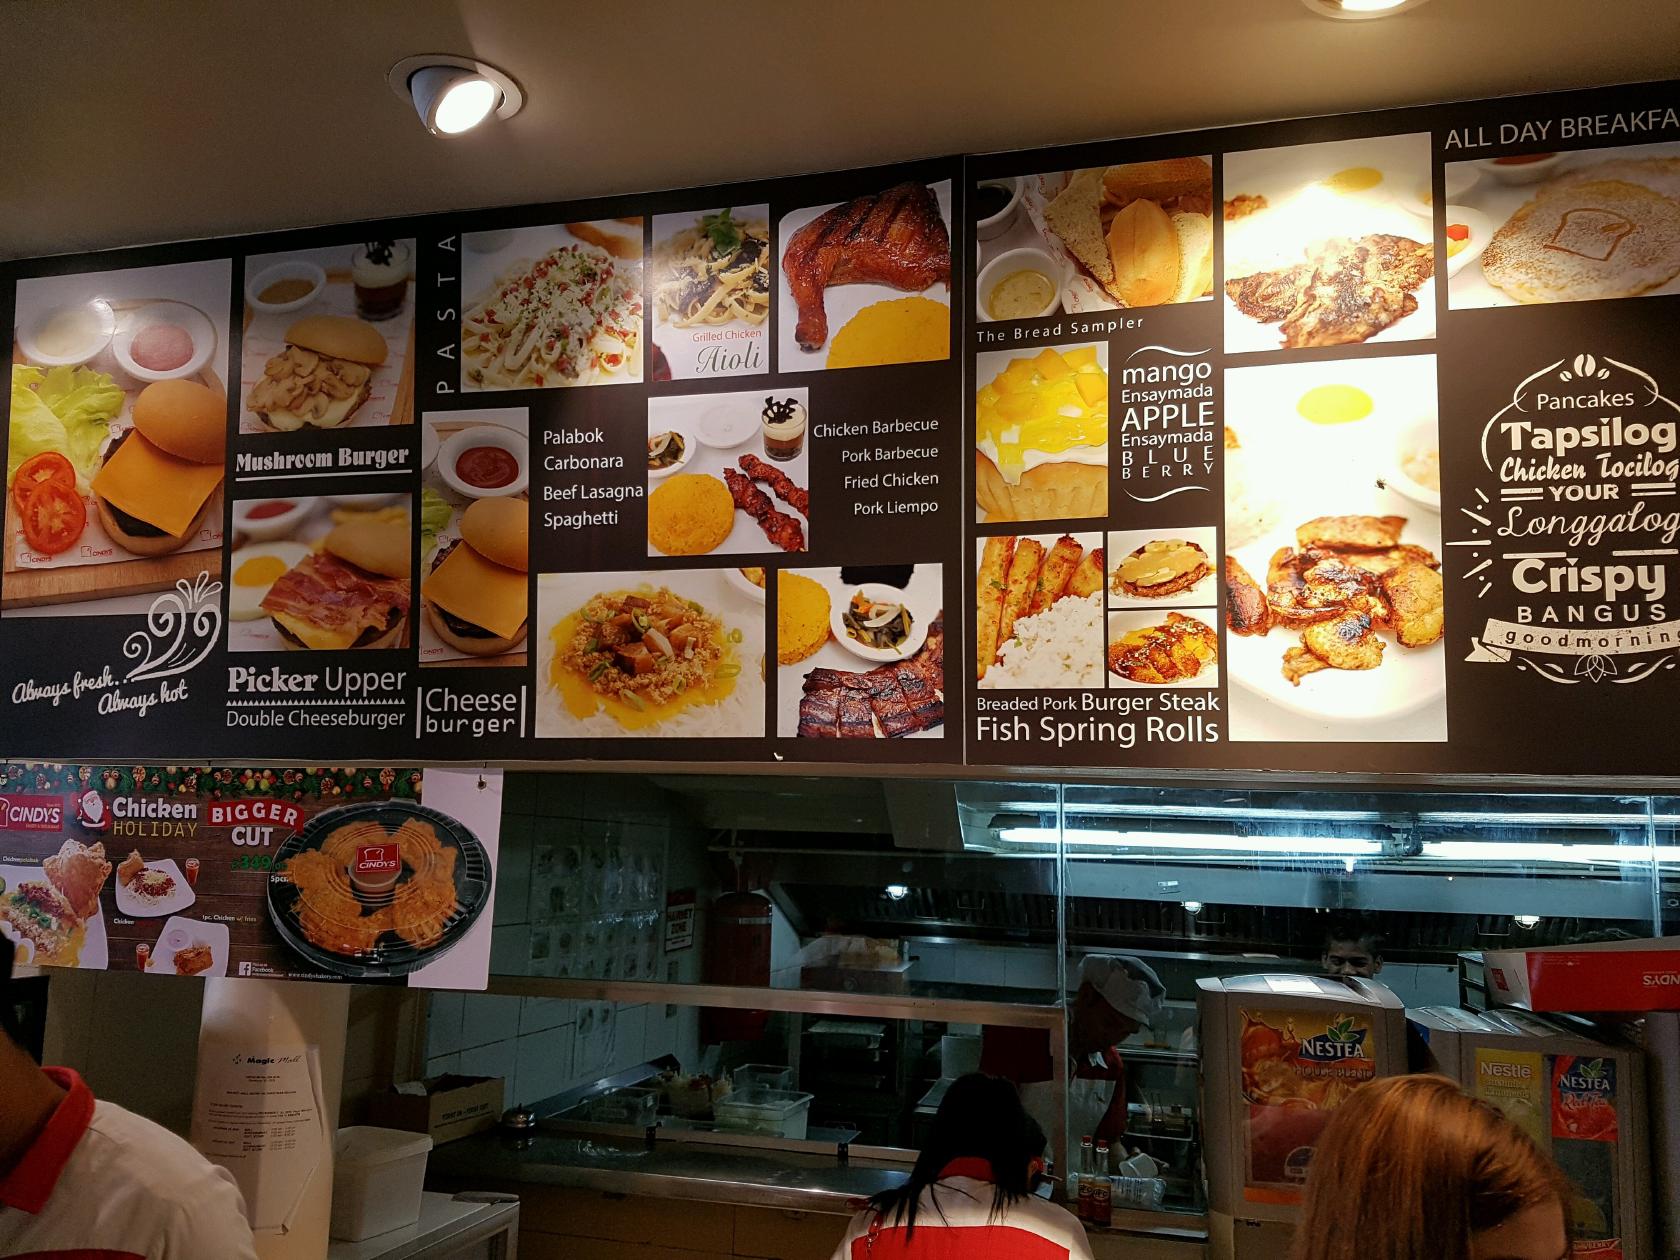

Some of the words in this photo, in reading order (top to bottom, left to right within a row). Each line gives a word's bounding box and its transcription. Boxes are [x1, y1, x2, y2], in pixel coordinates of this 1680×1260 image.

[1444, 127, 1492, 150] ALL
[1500, 120, 1552, 144] DAY
[436, 235, 456, 394] PASTA
[692, 331, 723, 342] Grilled
[725, 330, 762, 340] Chicken
[977, 330, 1006, 343] The
[1014, 323, 1062, 340] Bread
[1070, 318, 1144, 335] Sampler
[695, 341, 763, 374] Aioli
[1122, 362, 1212, 386] mango
[1121, 384, 1213, 404] Ensaymada
[1537, 390, 1635, 411] Pancakes
[1121, 401, 1215, 431] APPLE
[543, 427, 605, 445] Palabok
[813, 422, 868, 437] Chicken
[872, 418, 939, 434] Barbecue
[1500, 416, 1677, 457] Tapsilog
[1121, 428, 1213, 449] Ensaymada
[236, 451, 333, 472] Mushroom
[338, 447, 409, 469] Burger
[544, 454, 624, 471] Carbonara
[842, 448, 871, 462] Pork
[875, 446, 939, 461] Barbecue
[1122, 445, 1214, 467] BLUE
[844, 474, 879, 489] Fried
[882, 471, 939, 487] Chicken
[1122, 462, 1214, 480] BERRY
[1500, 456, 1587, 483] Chicken
[543, 485, 578, 501] Beef
[581, 485, 643, 501] Lasagna
[1548, 484, 1619, 502] YOUR
[854, 501, 884, 515] Pork
[887, 501, 939, 515] Liempo
[544, 510, 618, 530] Spaghetti
[1497, 501, 1680, 547] Longgalog
[1512, 557, 1666, 602] Crispy
[1517, 603, 1666, 624] BANGUS
[1504, 630, 1680, 649] goodmornin
[11, 678, 72, 706] Always
[228, 667, 318, 693] Picker
[325, 667, 407, 697] Upper
[98, 688, 158, 718] Always
[160, 678, 188, 700] hot
[425, 688, 517, 712] Cheese
[977, 697, 1038, 711] Breaded
[1043, 697, 1077, 711] Pork
[1081, 692, 1153, 716] Burger
[1159, 692, 1220, 711] Steak
[226, 711, 284, 727] Double
[288, 710, 406, 730] Cheeseburger
[425, 716, 516, 737] burger
[977, 716, 1031, 741] Fish
[1040, 717, 1136, 749] Spring
[1146, 716, 1219, 742] Rolls
[112, 797, 198, 819] Chicken
[211, 803, 298, 826] BIGGER
[113, 821, 198, 837] HOLIDAY
[231, 827, 274, 846] CUT
[213, 914, 236, 922] Chicken
[1302, 1038, 1364, 1057] NESTEA
[247, 1056, 275, 1065] Magic
[1560, 1073, 1610, 1091] NESTEA
